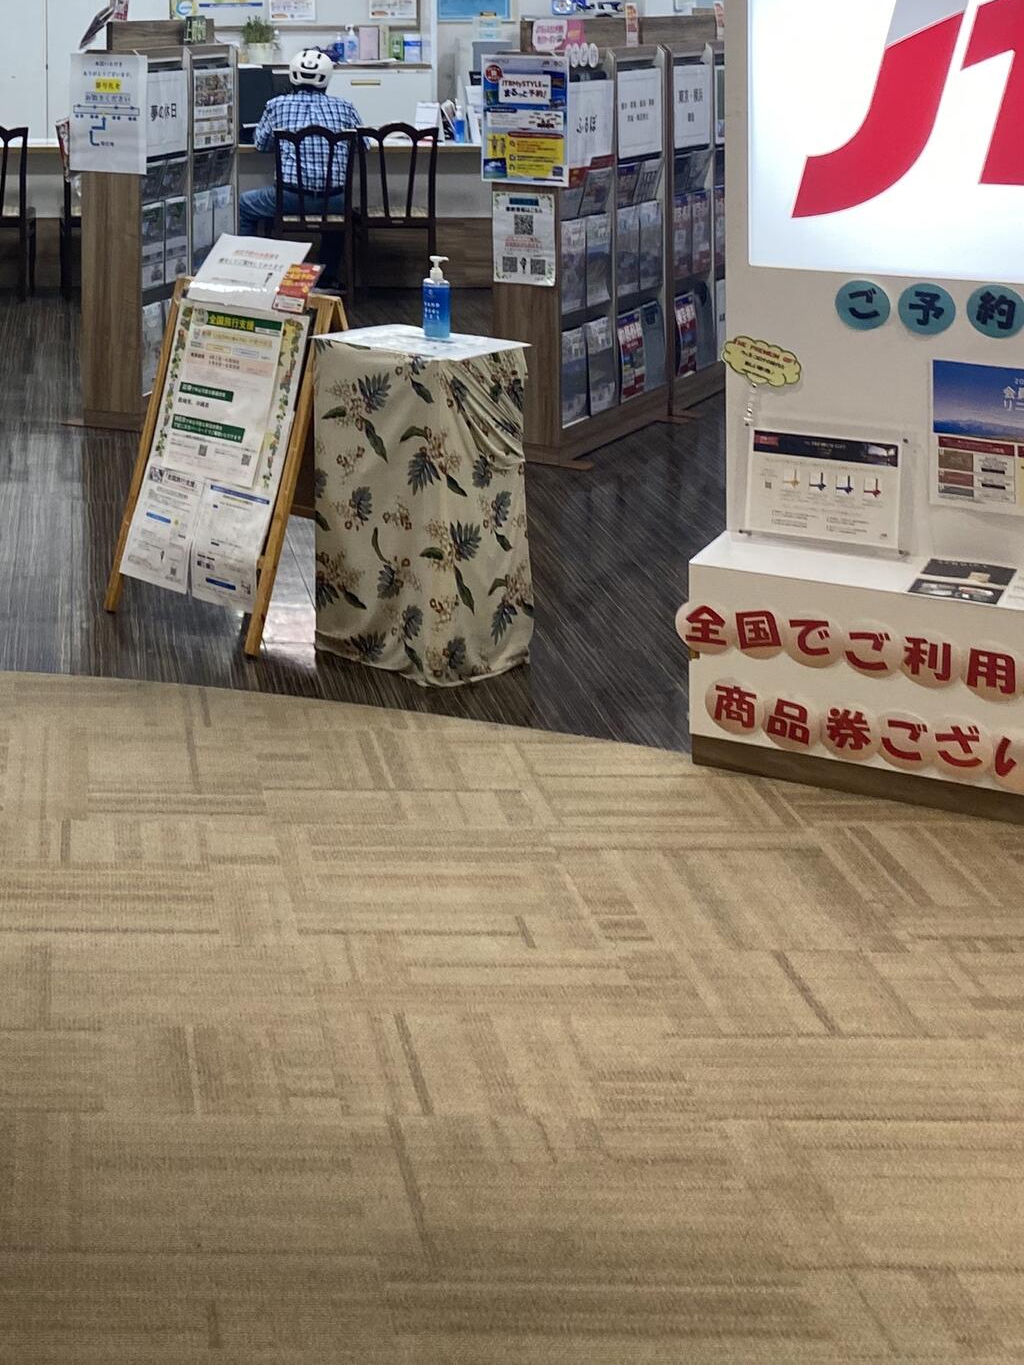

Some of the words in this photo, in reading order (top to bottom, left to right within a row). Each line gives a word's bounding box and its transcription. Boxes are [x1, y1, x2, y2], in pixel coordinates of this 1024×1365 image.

[151, 103, 177, 122] 夢の休日
[848, 288, 1017, 330] ご予約
[685, 604, 1017, 695] 全国でご利用
[713, 684, 1018, 778] 商品券ござい
